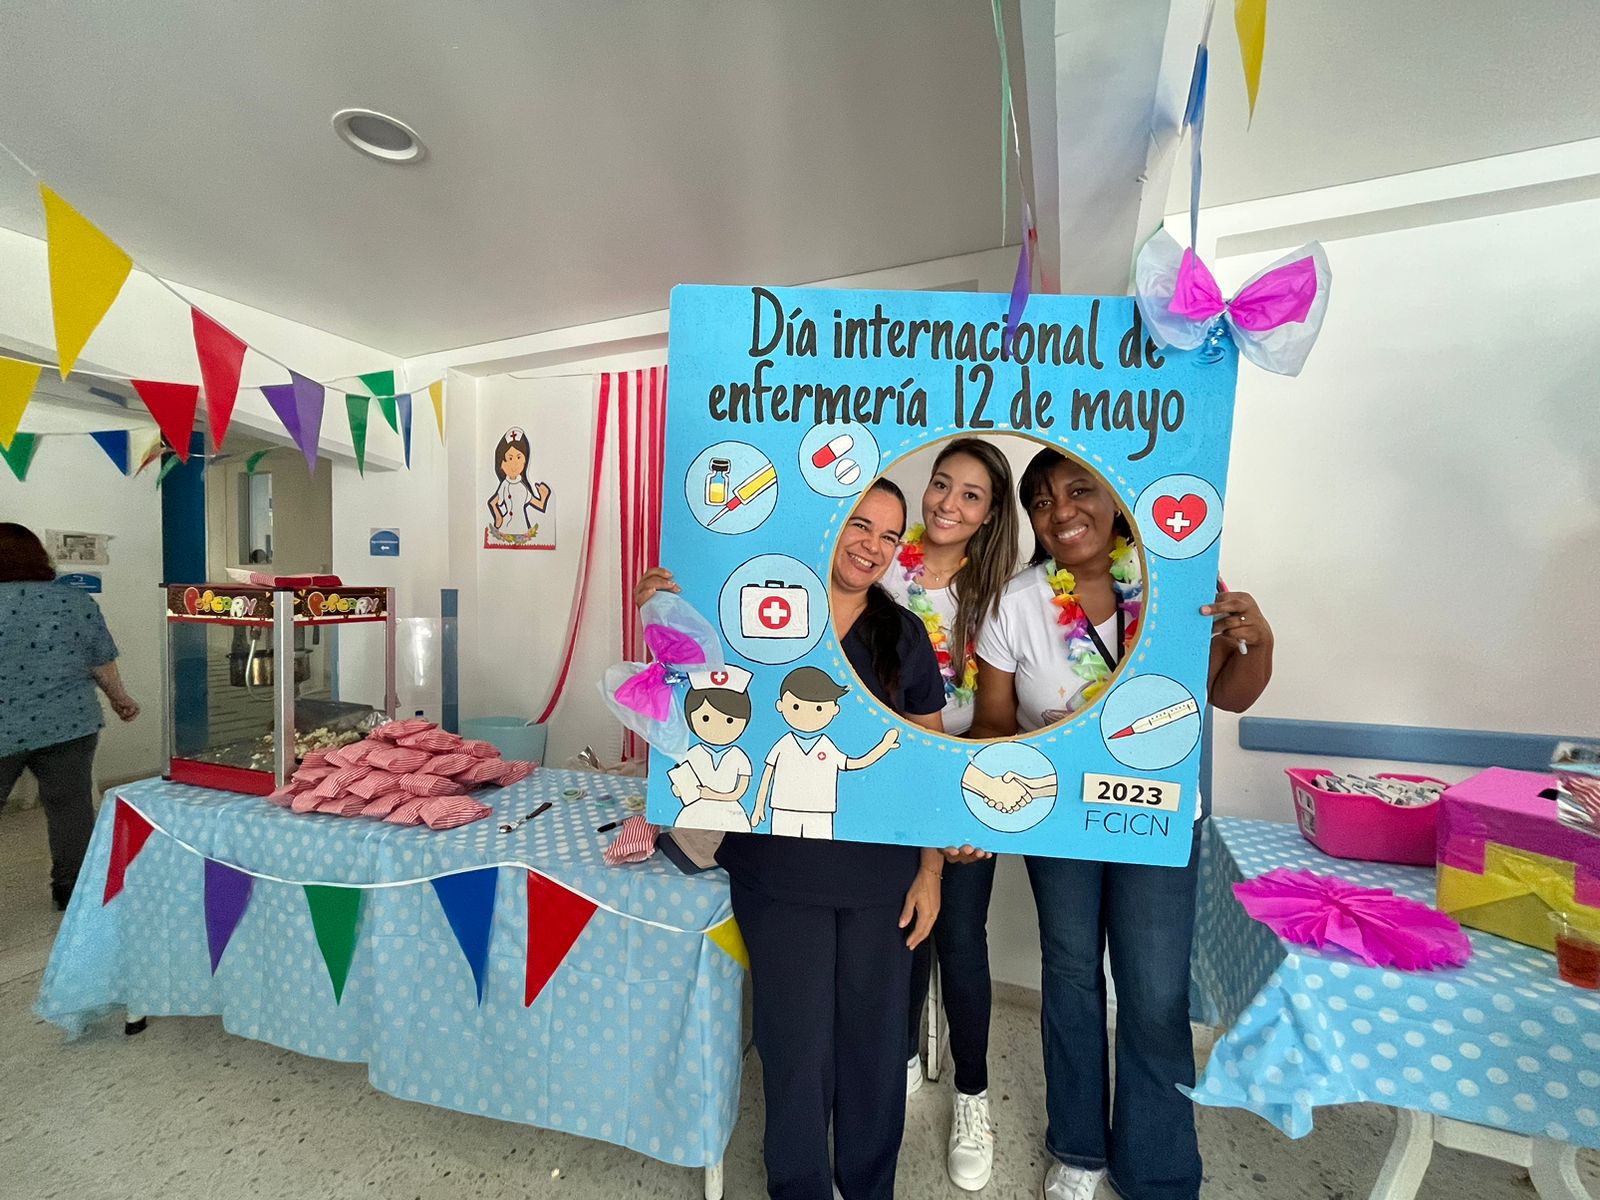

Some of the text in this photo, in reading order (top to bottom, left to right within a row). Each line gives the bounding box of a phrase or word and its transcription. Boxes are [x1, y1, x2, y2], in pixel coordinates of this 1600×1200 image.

[748, 286, 1165, 371] Día internacional de
[708, 360, 1185, 461] enfermería 12 de mayo
[1097, 781, 1163, 806] 2023
[1084, 809, 1170, 837] FCICN
